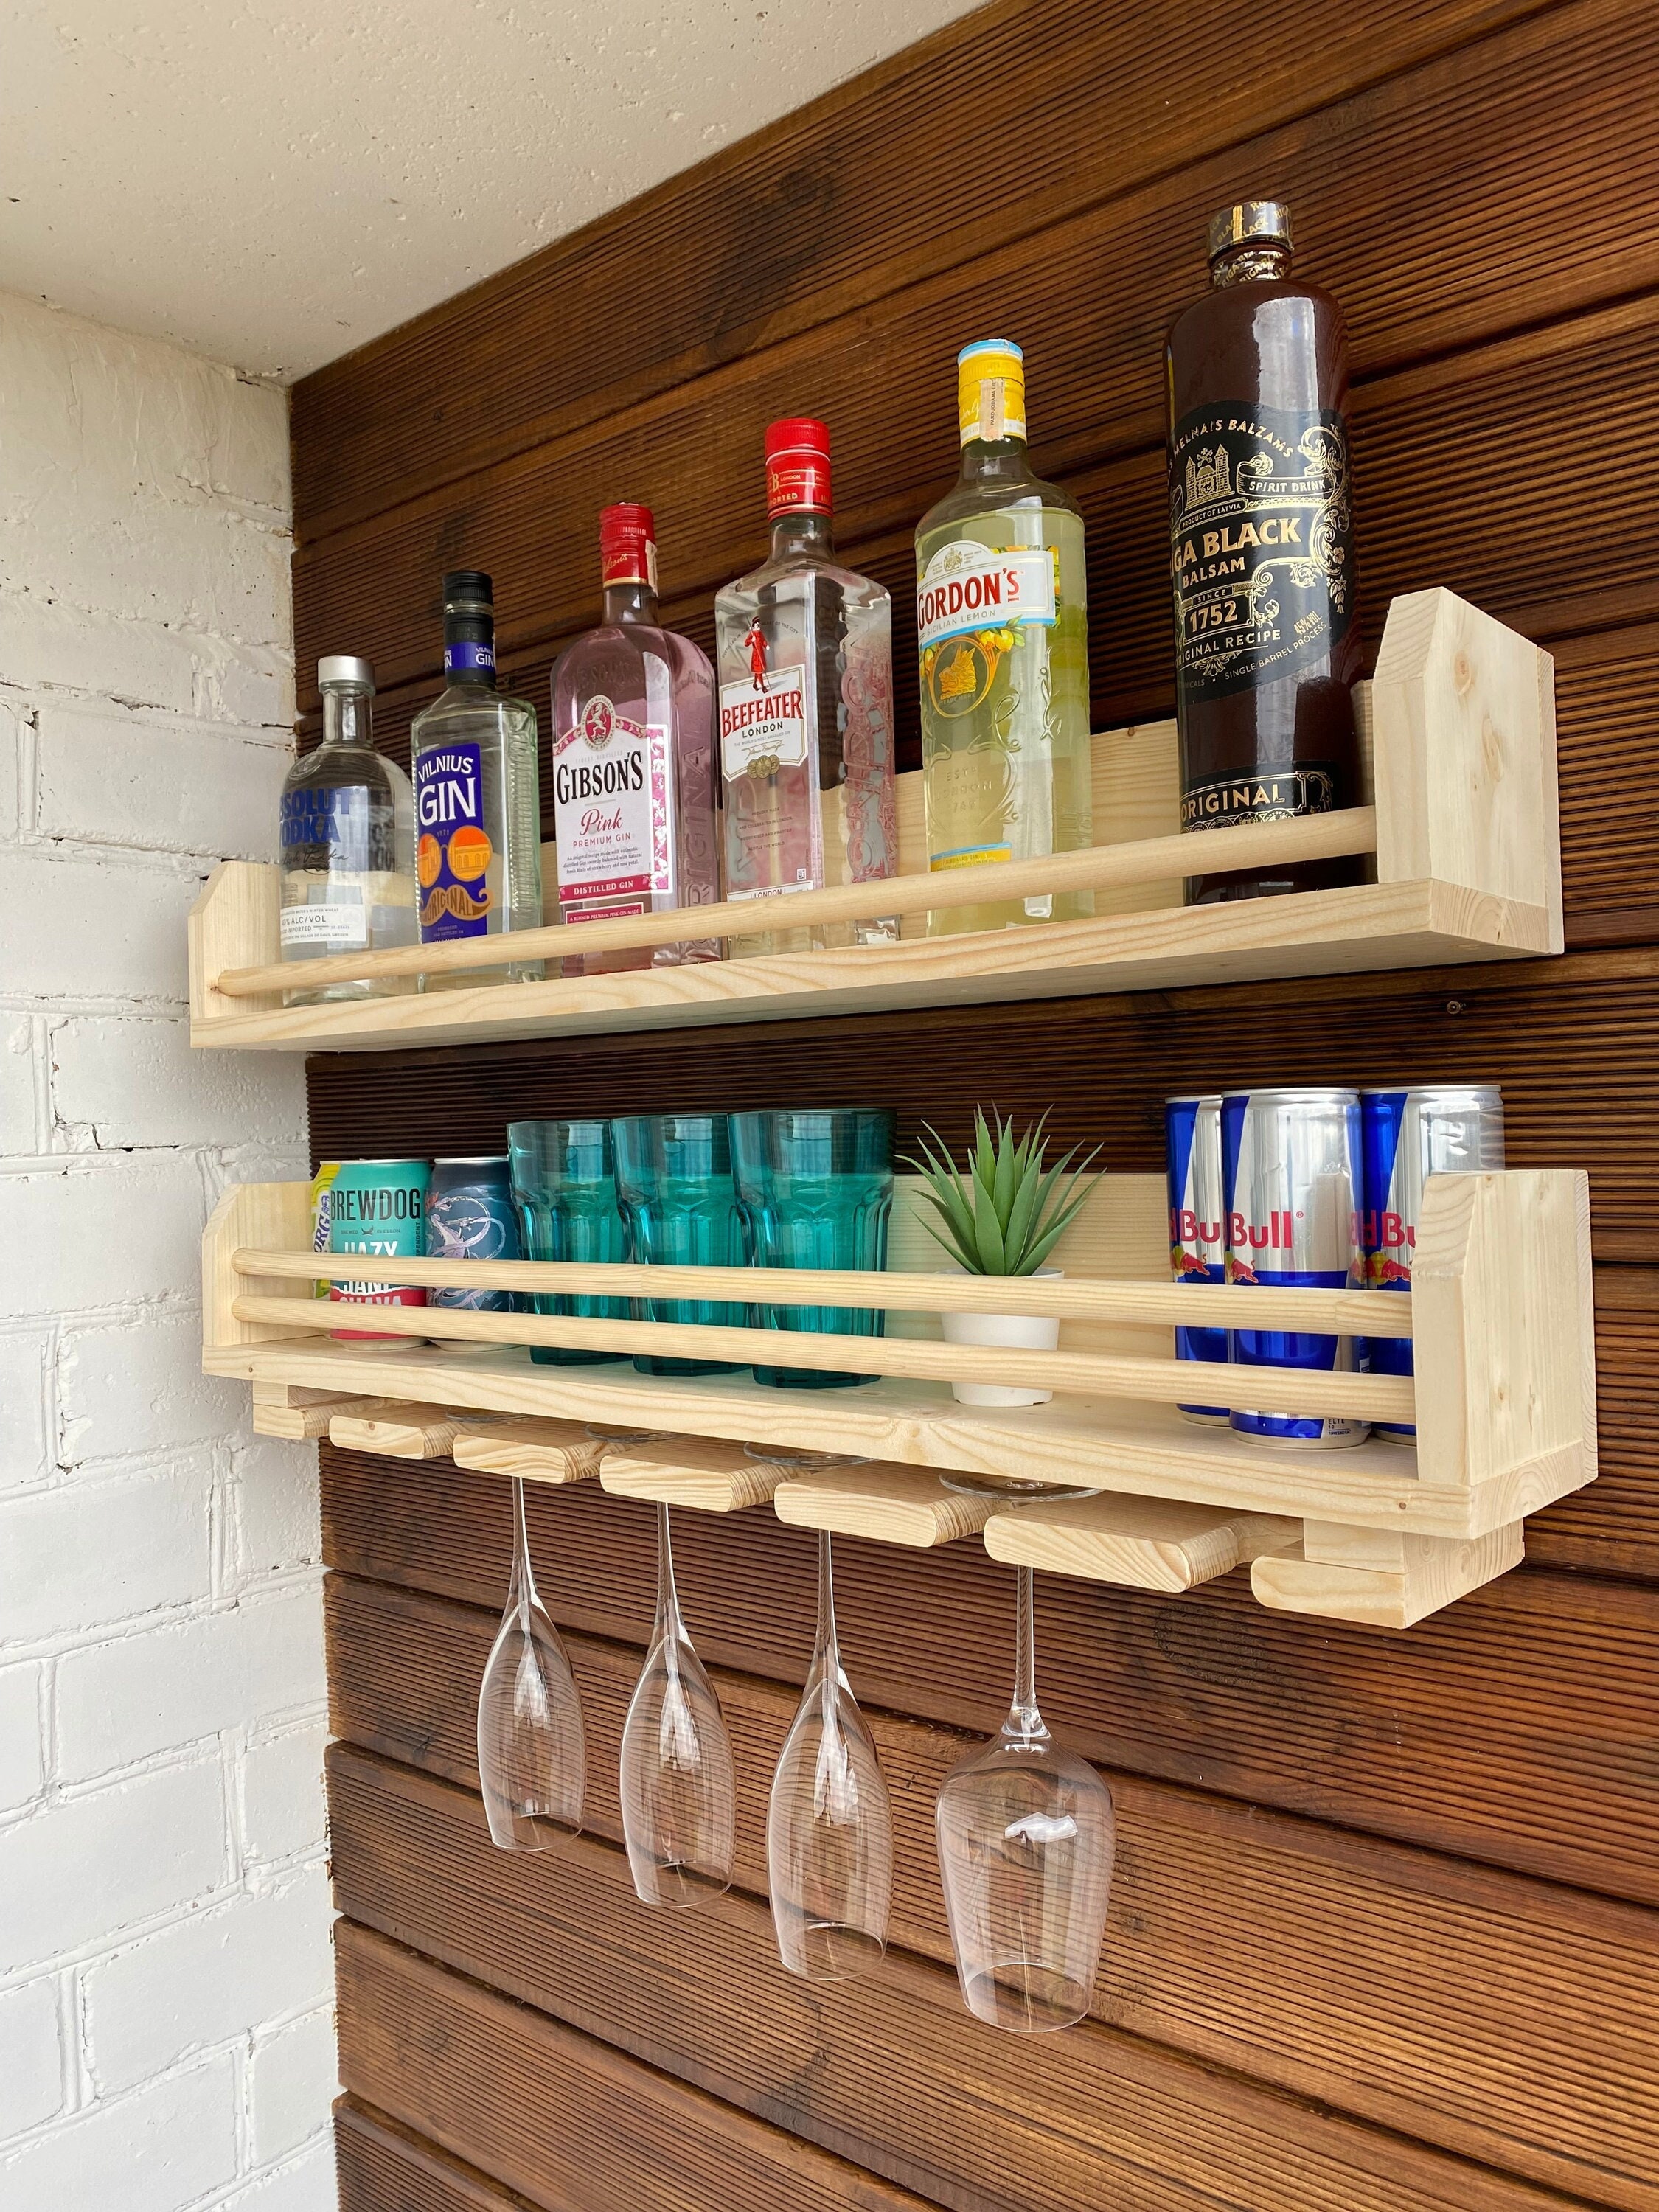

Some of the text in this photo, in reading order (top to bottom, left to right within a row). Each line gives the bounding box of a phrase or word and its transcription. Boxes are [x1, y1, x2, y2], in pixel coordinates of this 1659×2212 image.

[1173, 419, 1294, 459] MELNAIS BALZAMS
[1249, 479, 1326, 493] SPIRIT DRINK
[1182, 503, 1242, 528] PRODUCT OF LATVIA
[1174, 518, 1302, 572] GA BLACK
[1183, 557, 1245, 589] BALSAM
[918, 567, 1020, 631] GORDON'S
[1197, 589, 1227, 603] SINCE
[926, 609, 995, 636] SICILIAN LEMON
[1189, 600, 1238, 633] 1752
[1293, 617, 1312, 635] 45%
[476, 653, 495, 667] GIN
[1178, 629, 1281, 665] RIGINAL RECIPE
[1225, 662, 1257, 680] SINGLE
[1258, 647, 1293, 667] BARREL
[1293, 621, 1326, 650] PROCESS
[720, 689, 804, 739] BEEFEATER
[742, 721, 783, 738] LONDON
[418, 754, 473, 784] VILNIUS
[557, 750, 644, 804] GIBSON'S
[280, 787, 353, 820] SOLUT
[419, 777, 476, 827] GIN
[1180, 784, 1286, 823] ORIGINAL
[282, 815, 341, 847] ODKA
[579, 807, 623, 835] Pink
[573, 832, 631, 849] PREMIUM GIN
[574, 880, 634, 895] DISTILLED GIN
[754, 888, 782, 899] LONDON
[291, 915, 327, 925] ALC/VOL
[428, 887, 473, 921] ORIGINAL
[330, 1188, 420, 1221] BREWDOG
[1180, 1210, 1220, 1243] Bu
[1231, 1211, 1293, 1249] Bull
